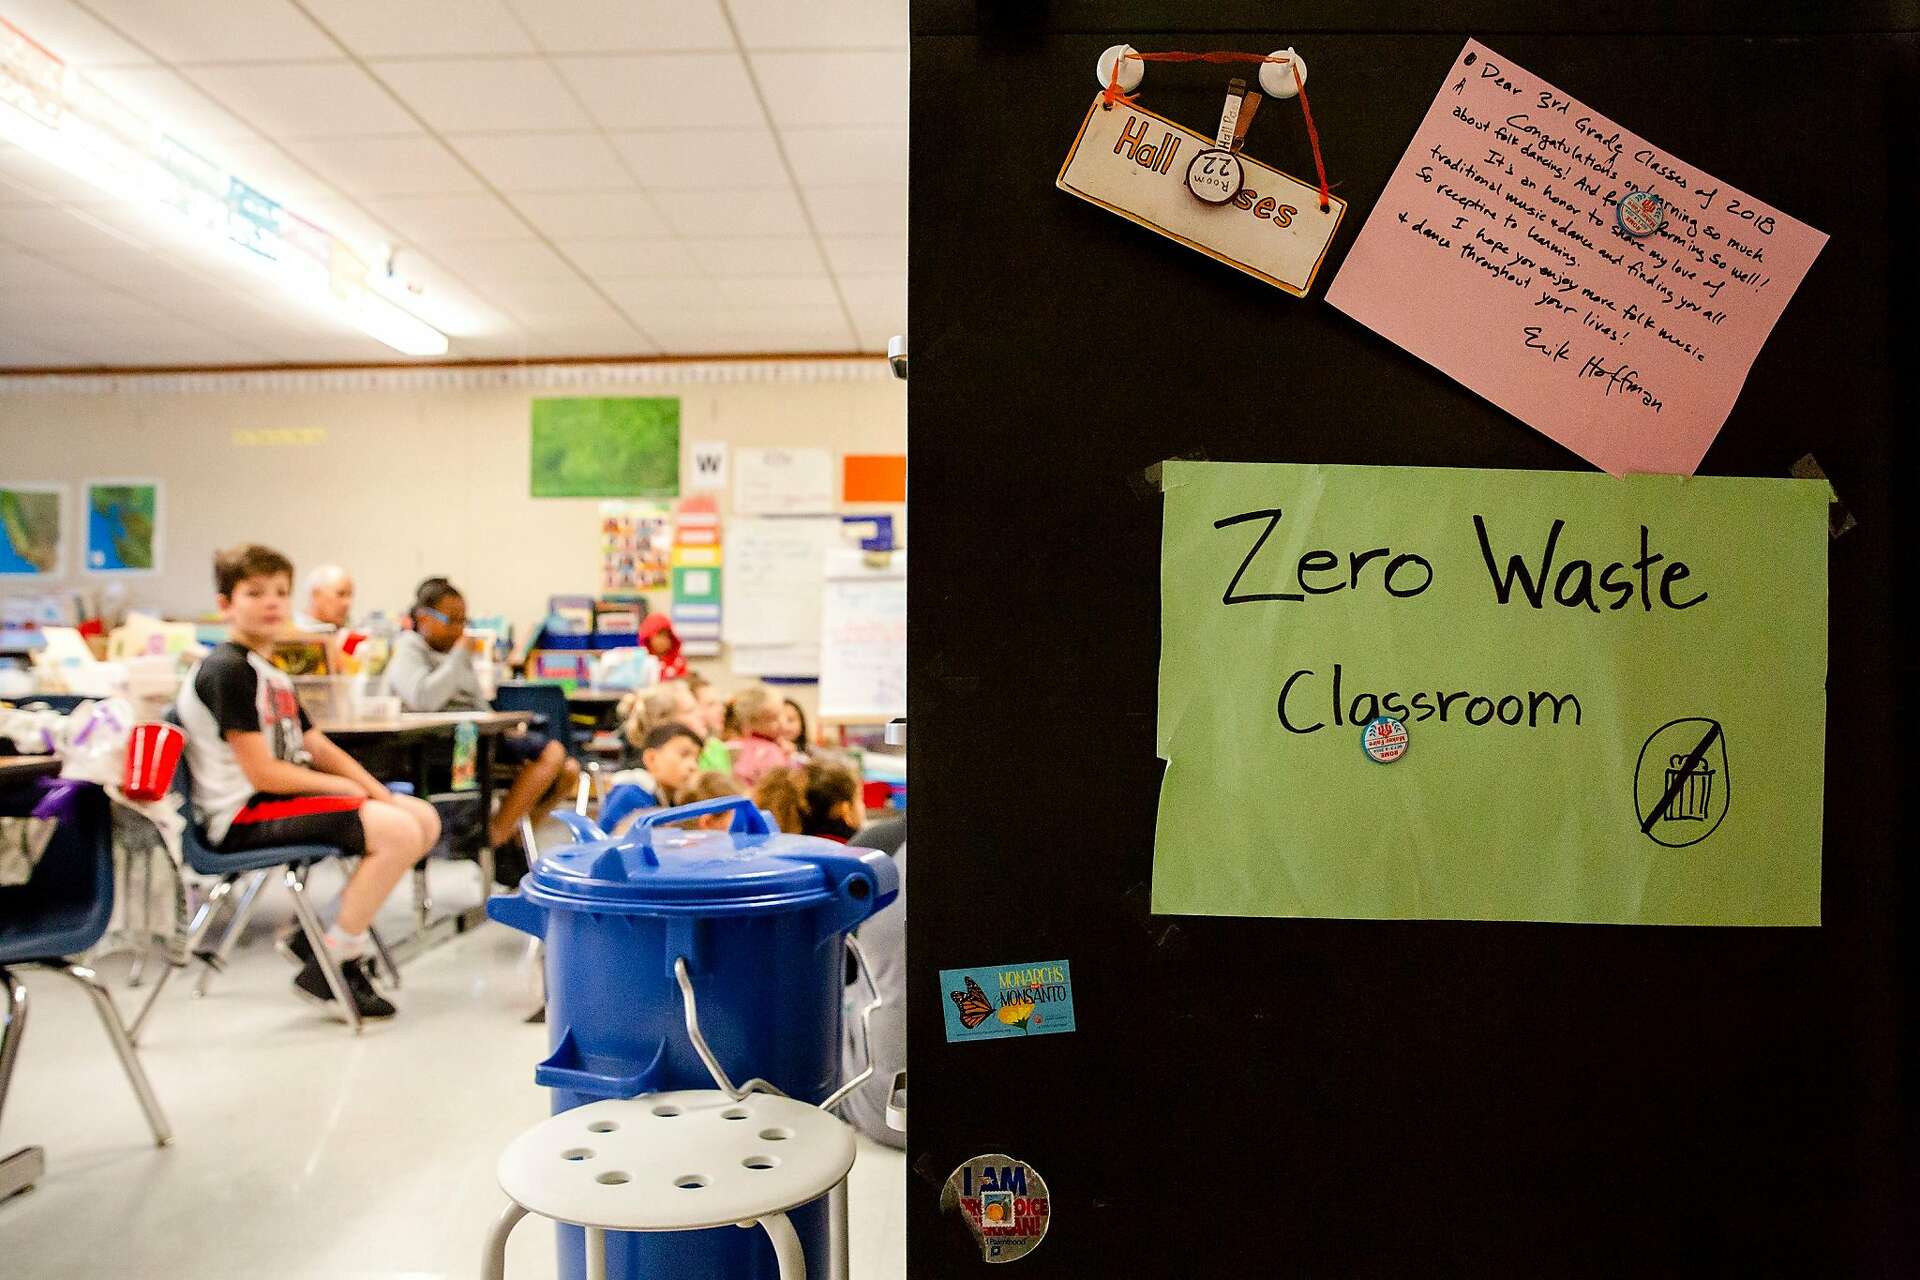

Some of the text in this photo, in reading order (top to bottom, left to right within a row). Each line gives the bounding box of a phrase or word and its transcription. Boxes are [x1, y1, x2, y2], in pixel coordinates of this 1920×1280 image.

[1113, 116, 1182, 175] Hall
[1218, 125, 1236, 150] Hall
[1481, 62, 1776, 235] Dear 3rd Grade Classes of 2018
[1193, 175, 1230, 193] Room
[1436, 184, 1497, 220] receptive
[1503, 213, 1518, 229] to
[1452, 105, 1491, 132] about
[1494, 127, 1519, 146] folk
[1520, 143, 1572, 180] dancing!
[1573, 176, 1601, 196] And
[1602, 190, 1618, 207] fo
[1730, 266, 1770, 293] well!
[1624, 180, 1640, 193] on
[1702, 225, 1721, 240] so
[1726, 238, 1763, 264] much
[1430, 144, 1503, 196] traditional
[1505, 192, 1547, 222] music
[1598, 249, 1625, 266] and
[1627, 261, 1673, 304] finding
[1674, 295, 1702, 312] you
[1702, 310, 1727, 325] all
[1520, 176, 1536, 189] an
[1542, 184, 1581, 215] honor
[1588, 208, 1604, 227] to
[1611, 225, 1645, 252] share
[1648, 250, 1668, 269] my
[1671, 259, 1697, 280] love
[1702, 280, 1726, 298] of
[1411, 218, 1451, 248] dance
[1460, 243, 1531, 289] throughout
[1534, 291, 1578, 314] your
[1583, 311, 1630, 346] lives!
[1451, 217, 1469, 230] I
[1475, 227, 1509, 255] hope
[1506, 252, 1536, 269] you
[1581, 288, 1617, 312] more
[1622, 303, 1655, 329] folk
[1658, 327, 1705, 362] music
[1523, 326, 1663, 413] Erik Hoffman
[1214, 508, 1709, 613] Zero Waste
[1277, 664, 1582, 734] Classroom
[998, 966, 1064, 988] MONARCHS
[1000, 985, 1066, 1007] MONSANTO
[963, 1166, 972, 1196] I
